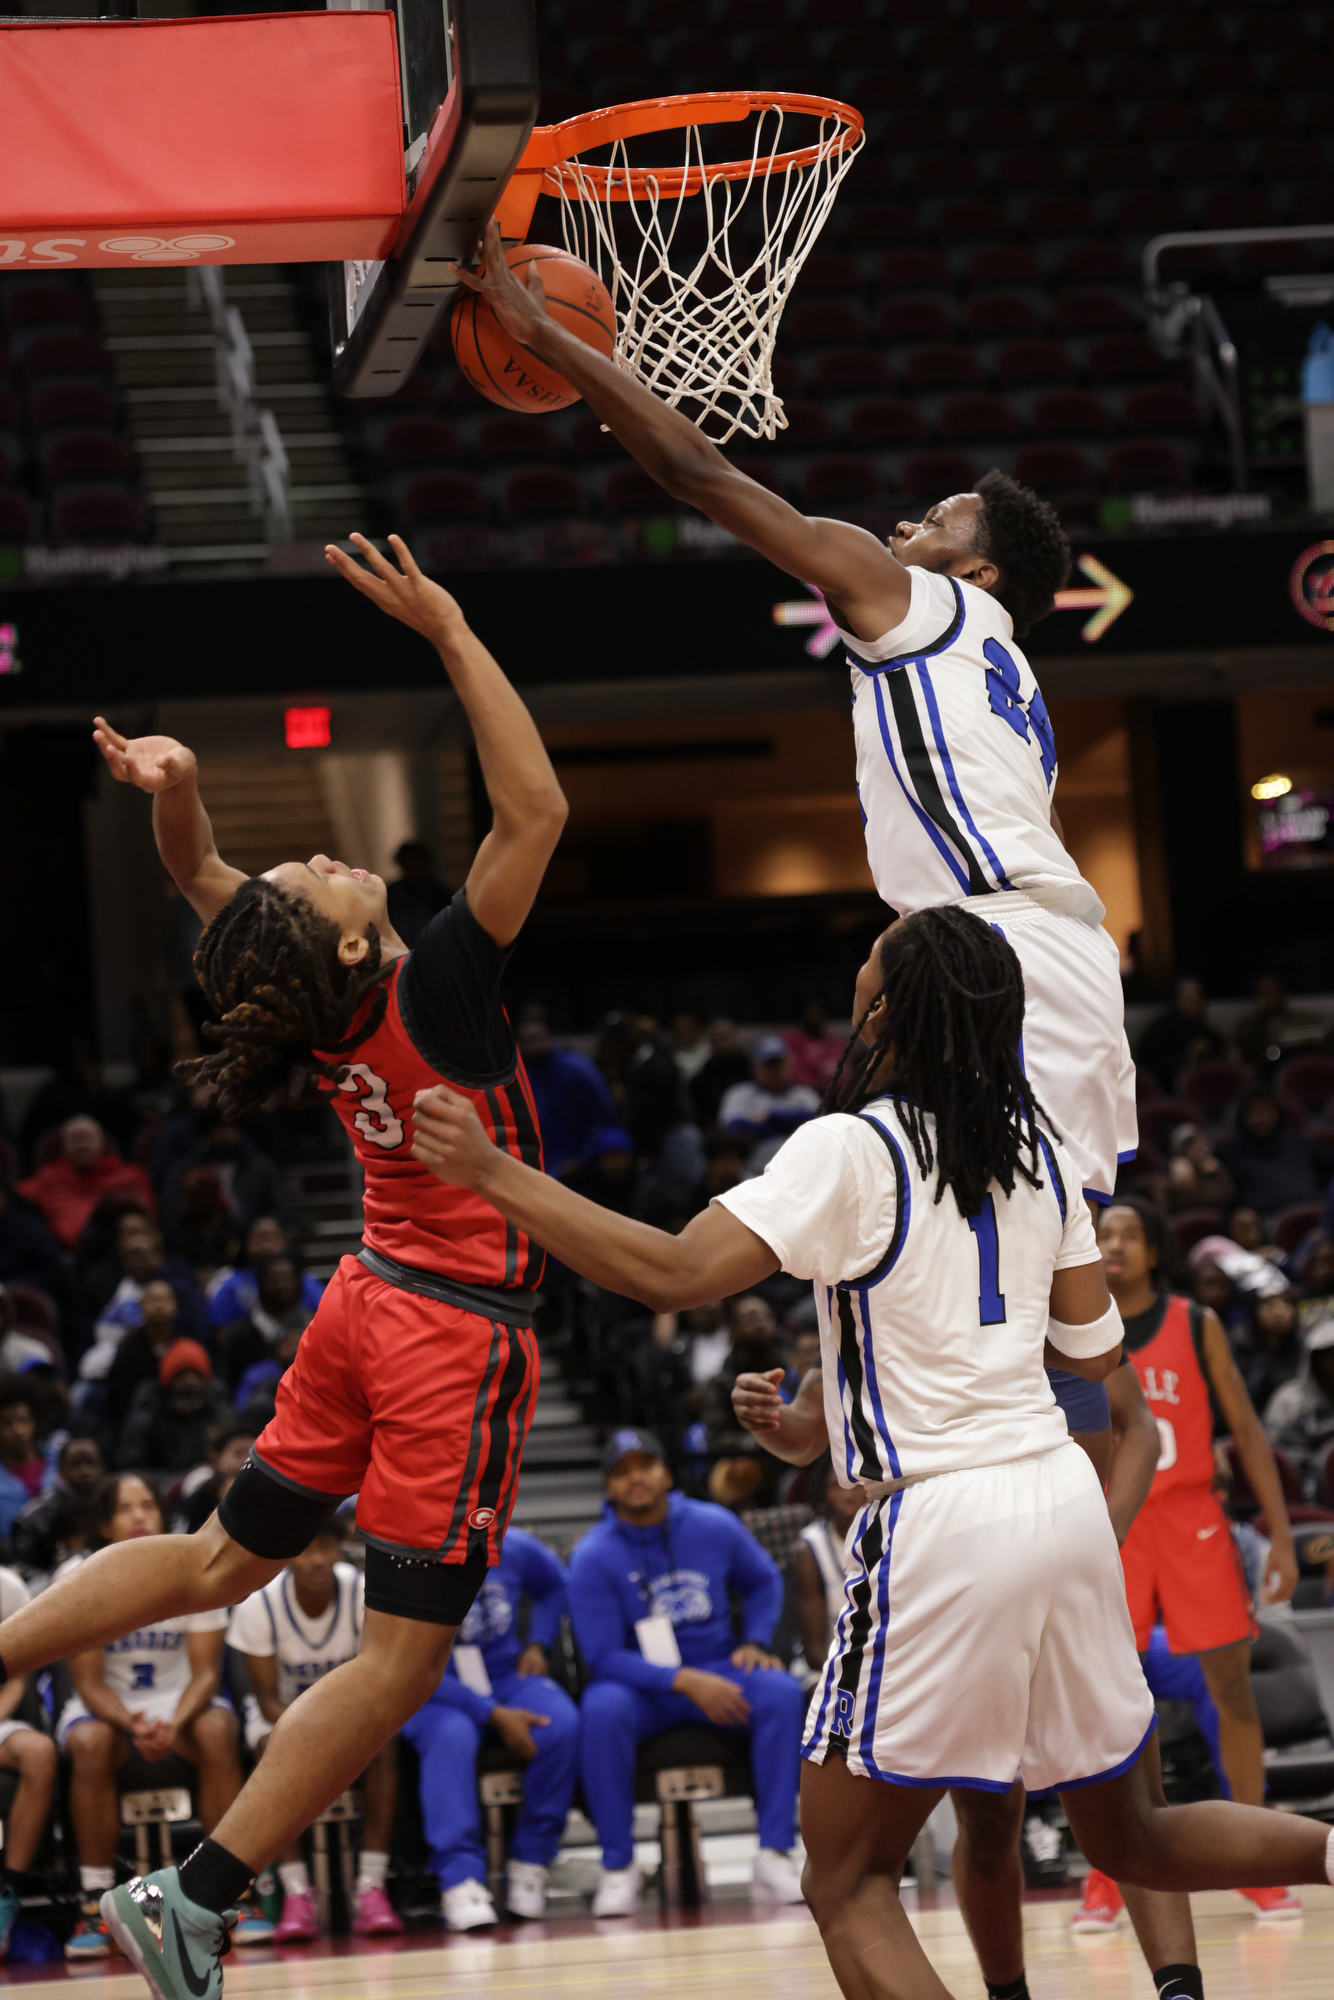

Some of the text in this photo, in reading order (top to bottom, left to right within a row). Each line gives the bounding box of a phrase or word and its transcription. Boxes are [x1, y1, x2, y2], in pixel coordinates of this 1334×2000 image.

[982, 636, 1057, 795] 24
[337, 1062, 405, 1151] 3
[965, 1191, 1007, 1326] 1
[1138, 1366, 1180, 1406] LE
[468, 1507, 496, 1530] G
[830, 1687, 856, 1739] R
